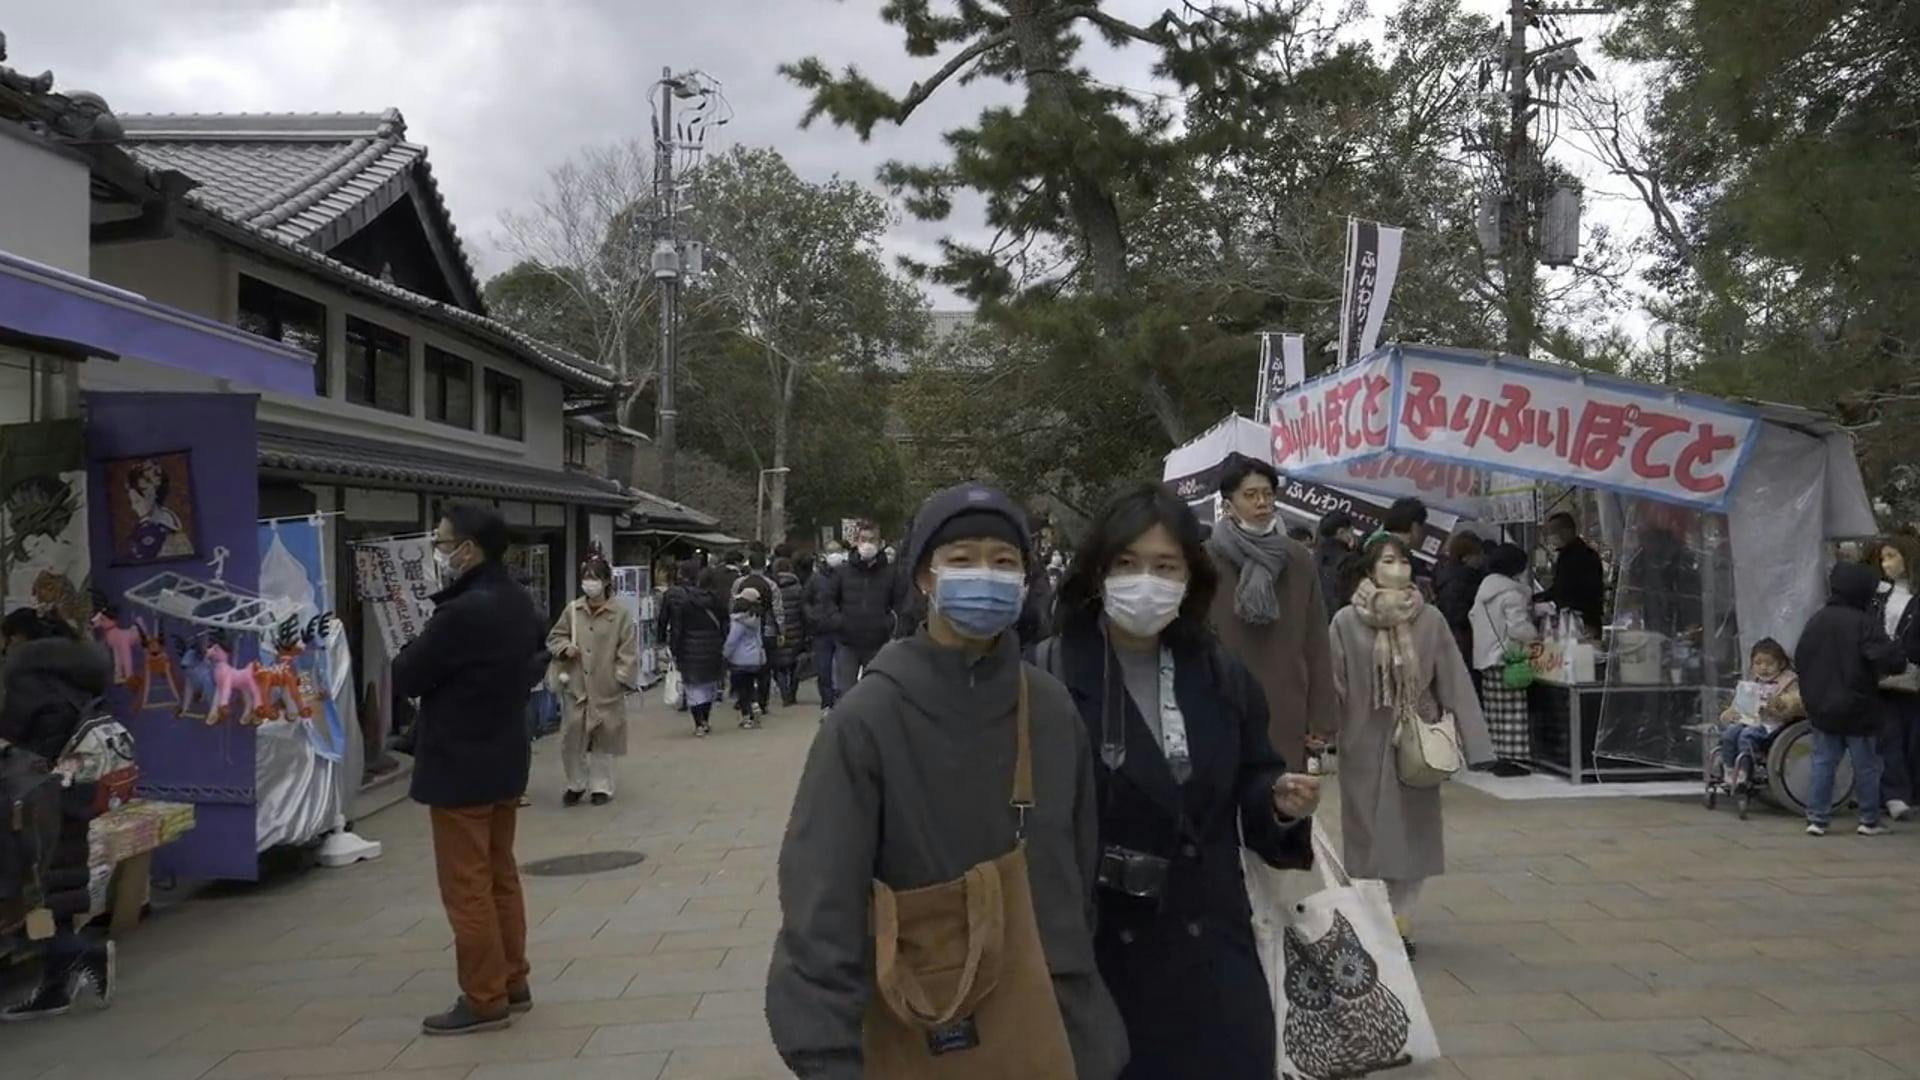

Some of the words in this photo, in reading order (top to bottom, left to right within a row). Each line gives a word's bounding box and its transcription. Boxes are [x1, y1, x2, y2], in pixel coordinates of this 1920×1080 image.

[1357, 250, 1377, 323] ふんわり
[1285, 480, 1352, 514] ふんわり
